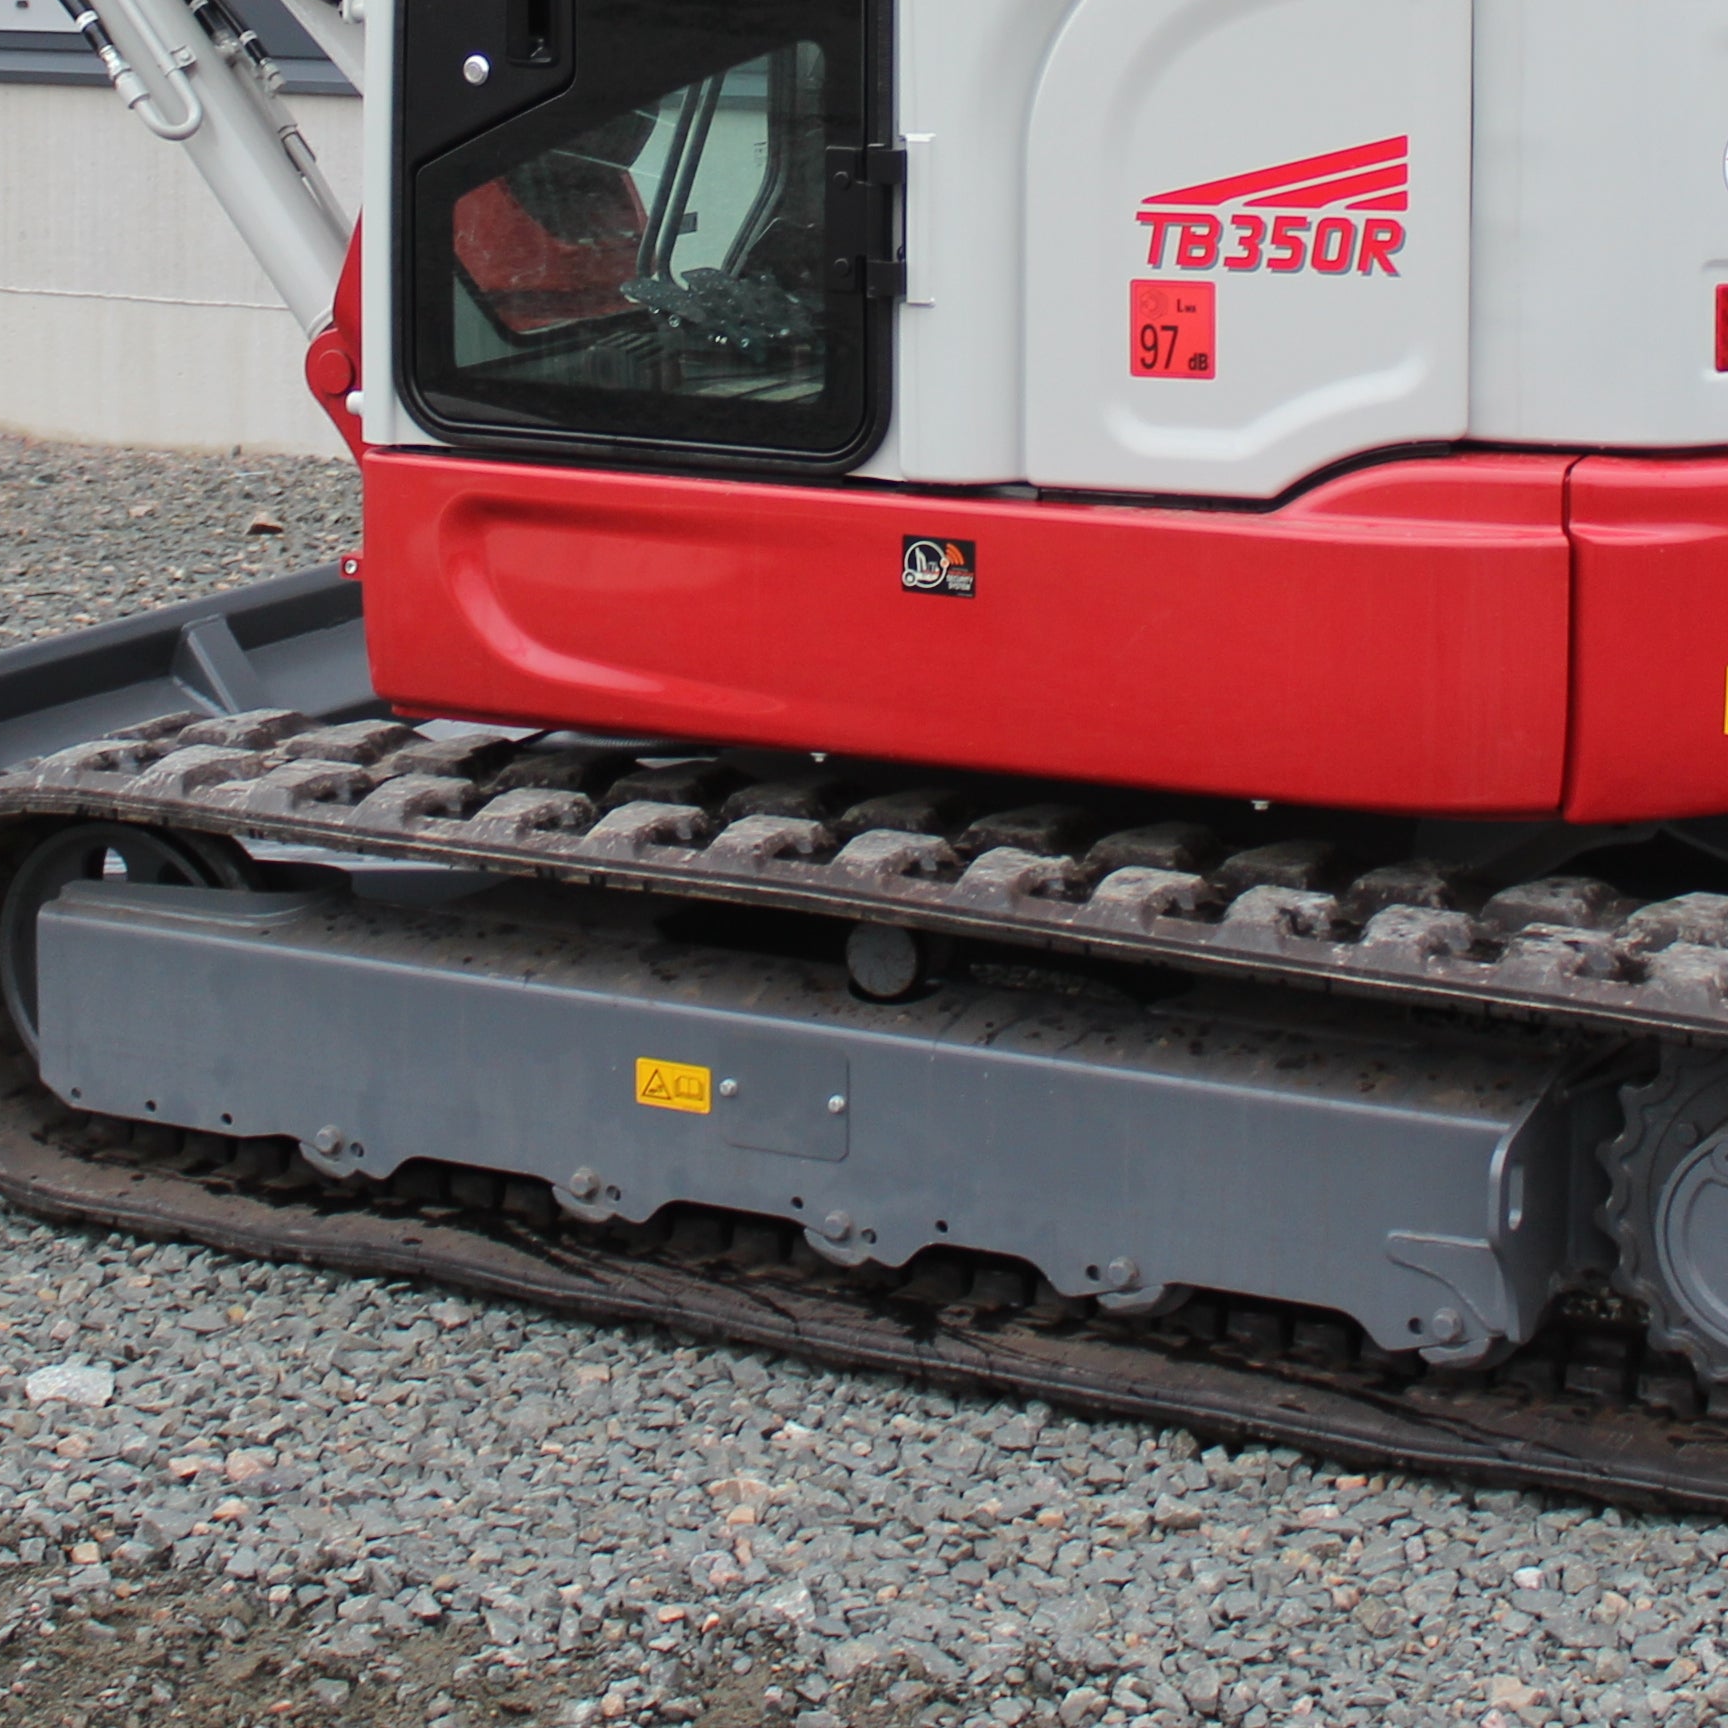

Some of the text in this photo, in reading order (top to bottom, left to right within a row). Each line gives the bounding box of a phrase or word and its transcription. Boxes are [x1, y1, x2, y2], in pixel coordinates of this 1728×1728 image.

[1136, 210, 1407, 278] TB350R
[1140, 323, 1208, 371] 97 dB
